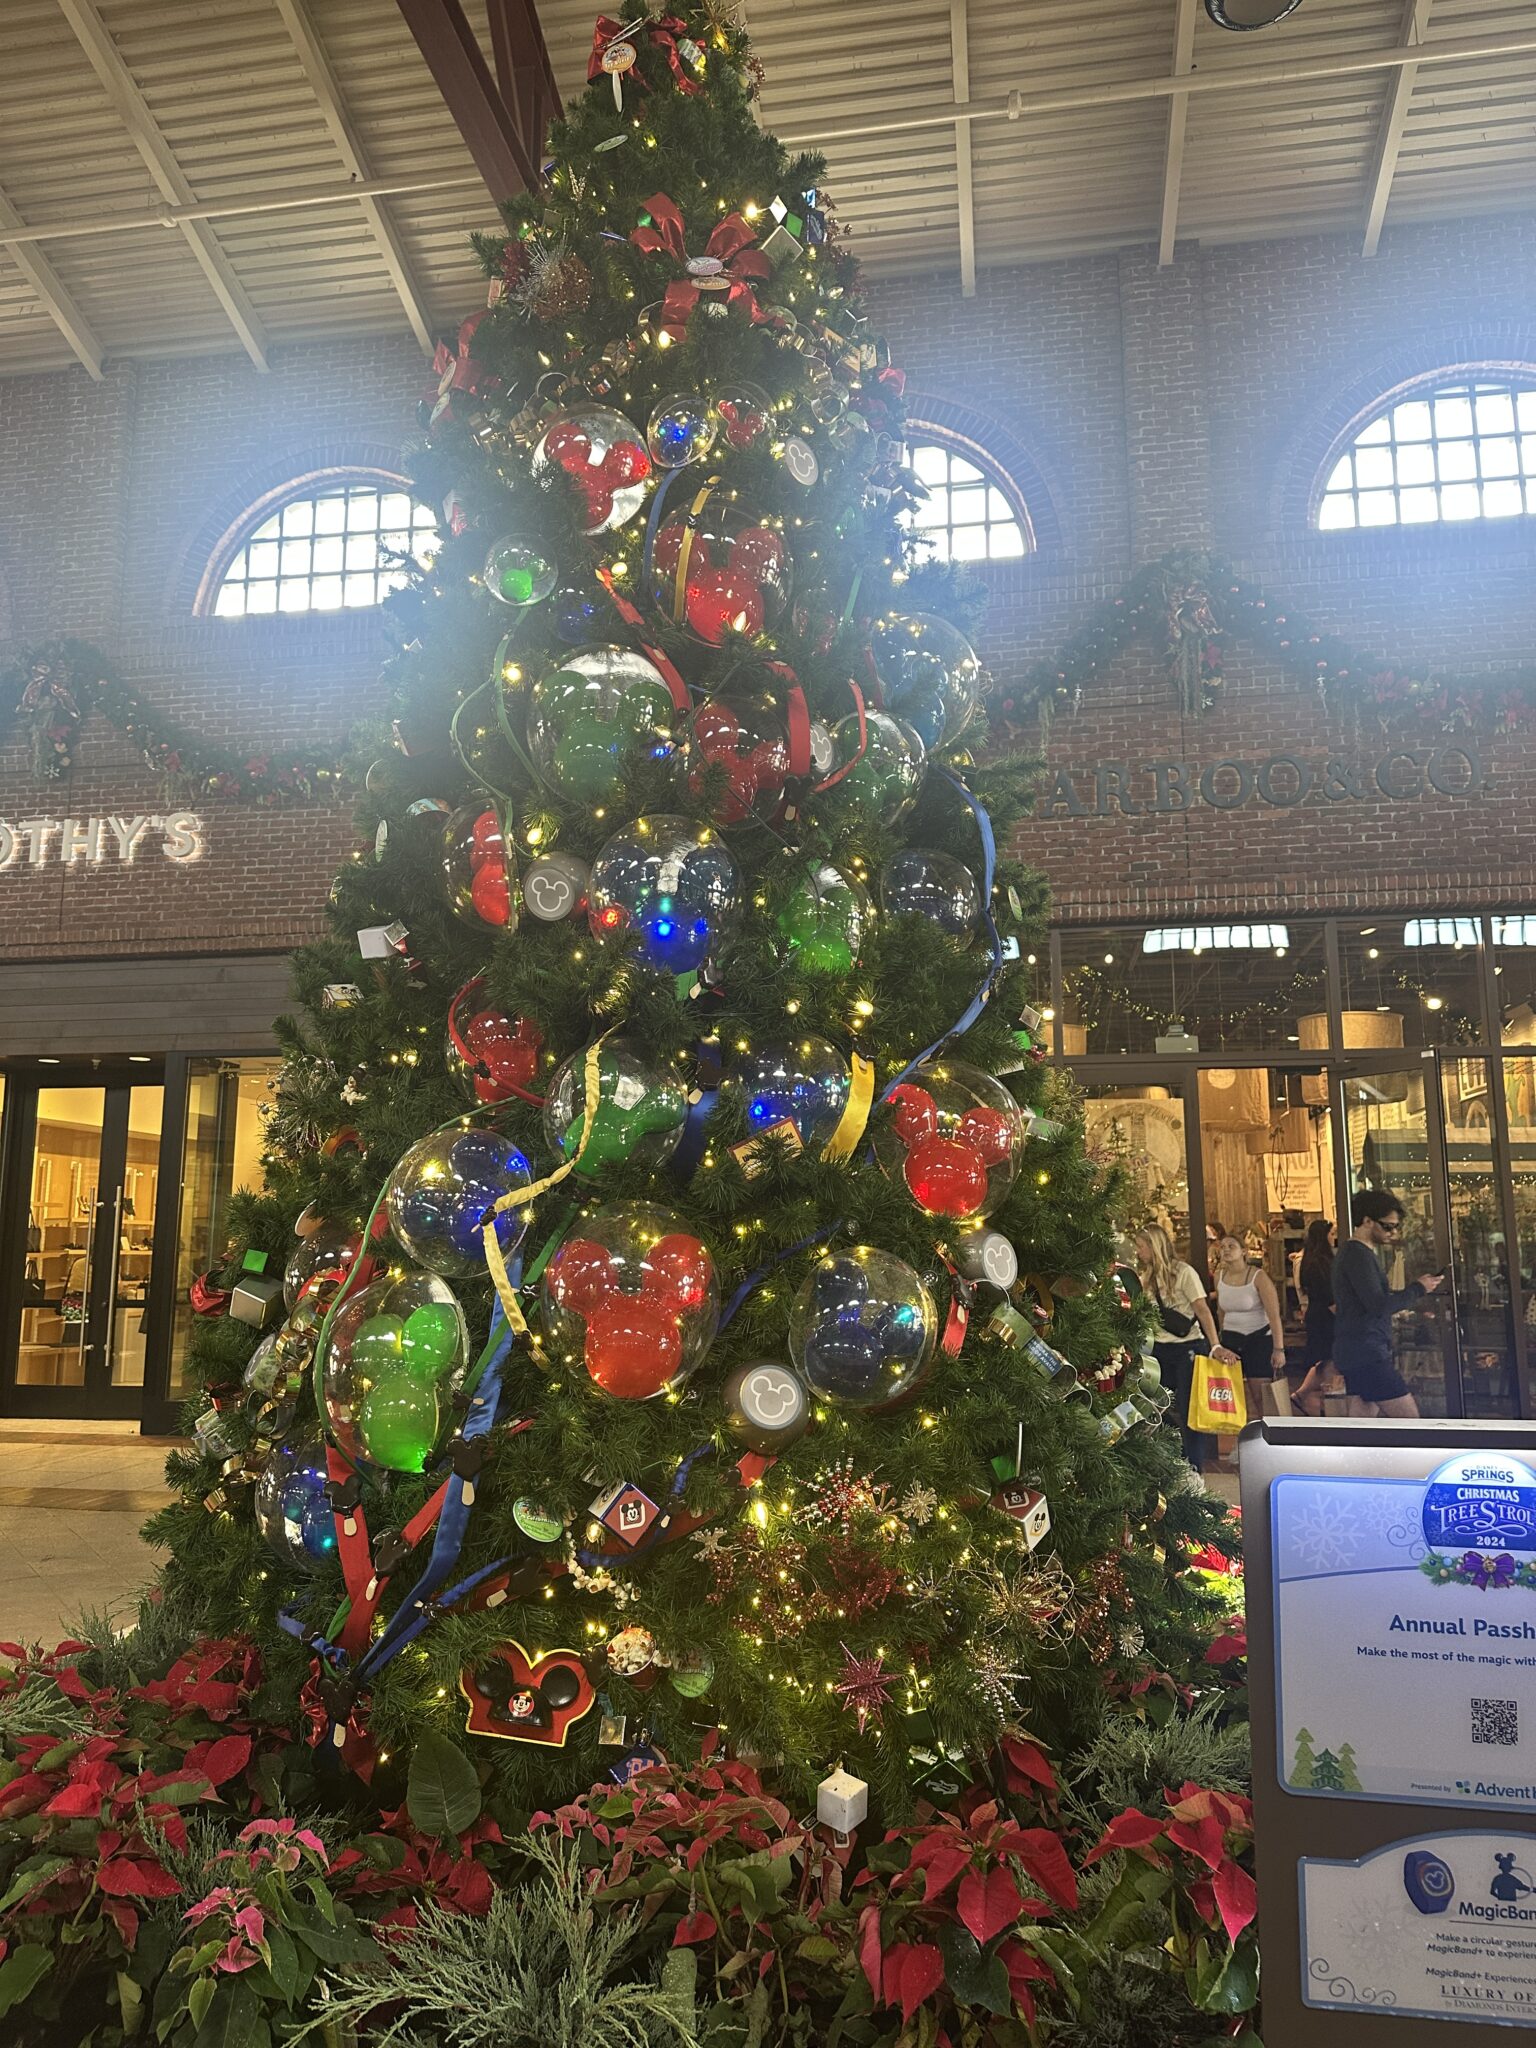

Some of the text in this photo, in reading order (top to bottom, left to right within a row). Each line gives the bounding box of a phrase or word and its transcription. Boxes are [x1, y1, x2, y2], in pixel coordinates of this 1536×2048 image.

[1461, 1469, 1514, 1483] SPRINGS
[1456, 1487, 1520, 1503] CHRISTMAS
[1476, 1535, 1506, 1546] 2024
[1389, 1614, 1467, 1635] Annual
[1357, 1646, 1387, 1657] Make
[1390, 1648, 1408, 1658] the
[1411, 1650, 1439, 1660] most
[1443, 1651, 1454, 1661] of
[1457, 1653, 1476, 1663] the
[1478, 1655, 1512, 1667] magic
[1410, 1782, 1442, 1790] Presented
[1436, 1933, 1461, 1943] Make
[1470, 1936, 1504, 1946] circular
[1427, 1943, 1483, 1955] MagicBand+
[1486, 1949, 1496, 1957] to
[1426, 1967, 1482, 1978] MagicBand+
[1441, 1985, 1504, 1999] LUXURY
